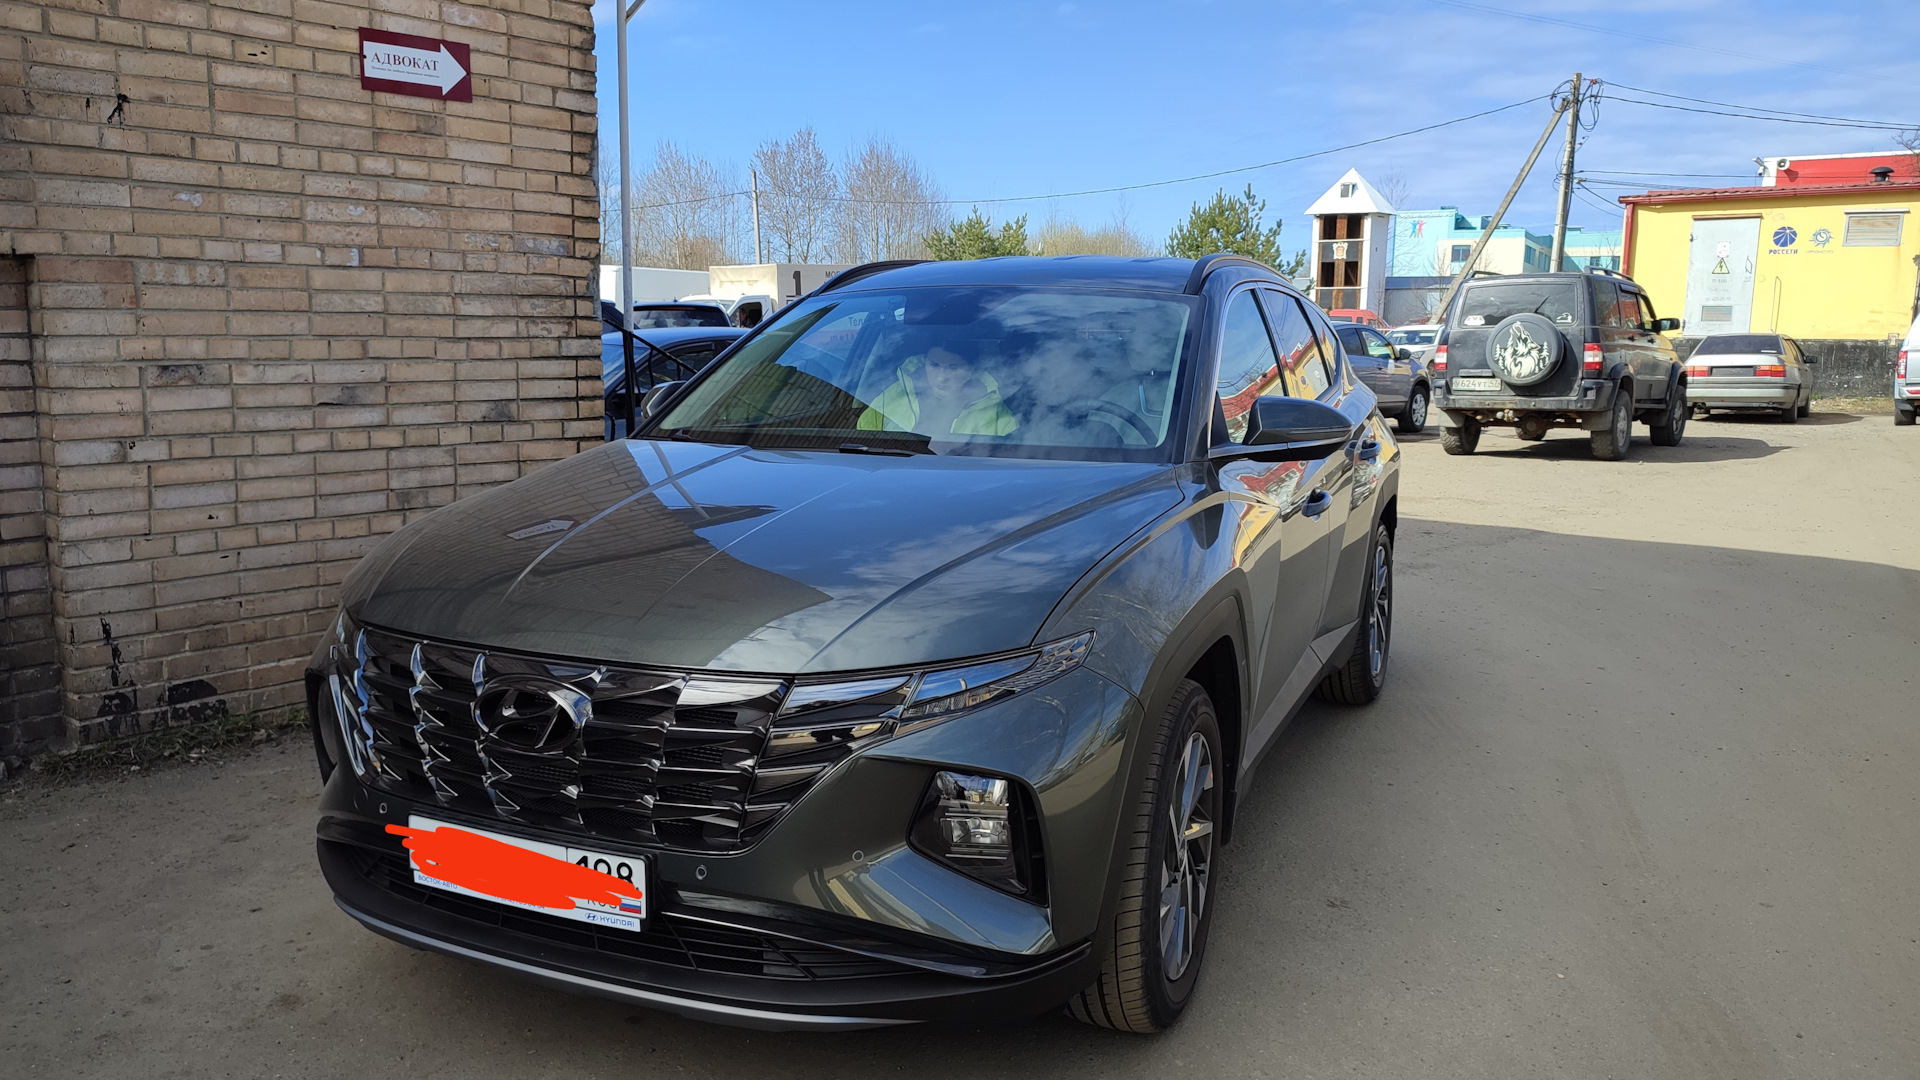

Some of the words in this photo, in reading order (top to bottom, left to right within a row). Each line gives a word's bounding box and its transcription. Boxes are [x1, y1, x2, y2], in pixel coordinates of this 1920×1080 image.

[371, 52, 439, 71] АДВОКАТ
[417, 874, 458, 890] ВОСТОК-АВТО
[600, 915, 635, 928] HYUNDAI
